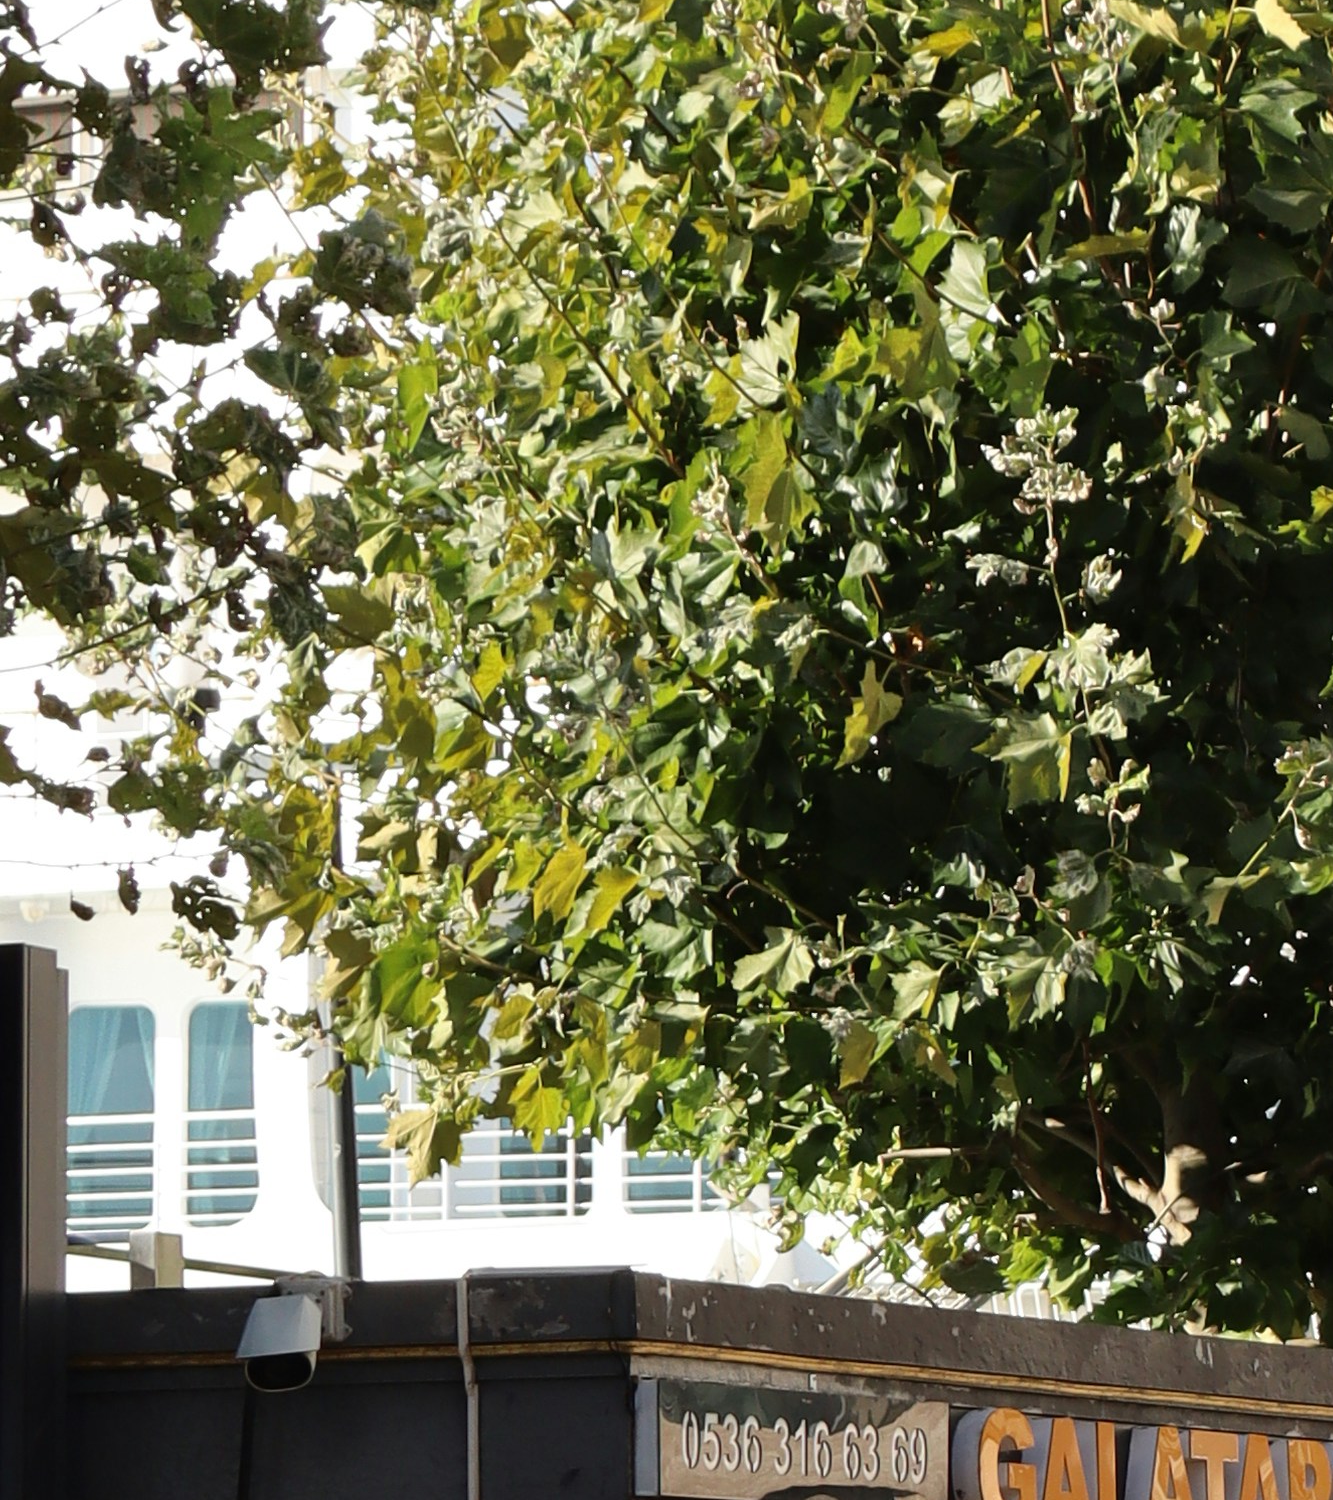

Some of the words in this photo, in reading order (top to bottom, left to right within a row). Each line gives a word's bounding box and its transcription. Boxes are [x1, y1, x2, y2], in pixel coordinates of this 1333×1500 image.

[682, 1410, 762, 1474] 0536
[773, 1416, 832, 1477] 316
[843, 1422, 880, 1482] 63
[891, 1426, 928, 1485] 69
